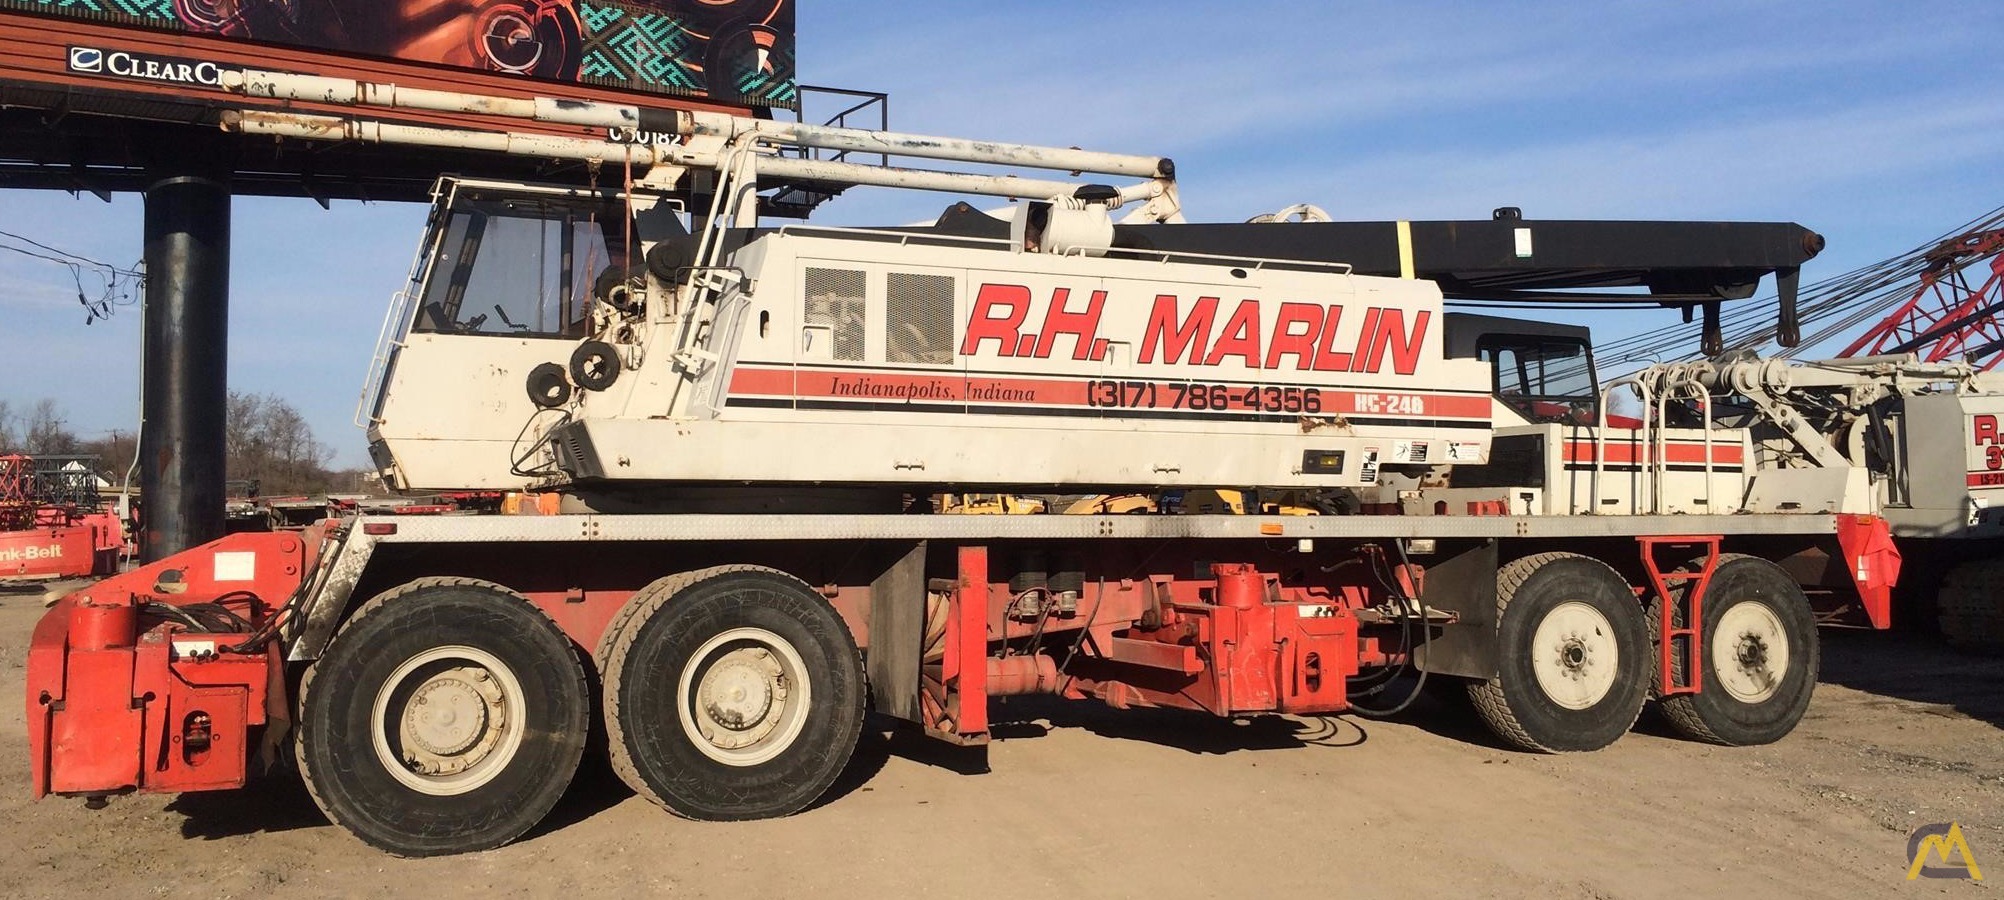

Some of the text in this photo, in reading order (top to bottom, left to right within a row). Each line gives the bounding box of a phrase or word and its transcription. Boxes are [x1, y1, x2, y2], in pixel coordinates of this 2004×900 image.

[959, 283, 1432, 375] R.H. MARLIN
[831, 377, 1036, 404] Indianapolis, Indiana
[1087, 380, 1322, 414] (317) 786-4356
